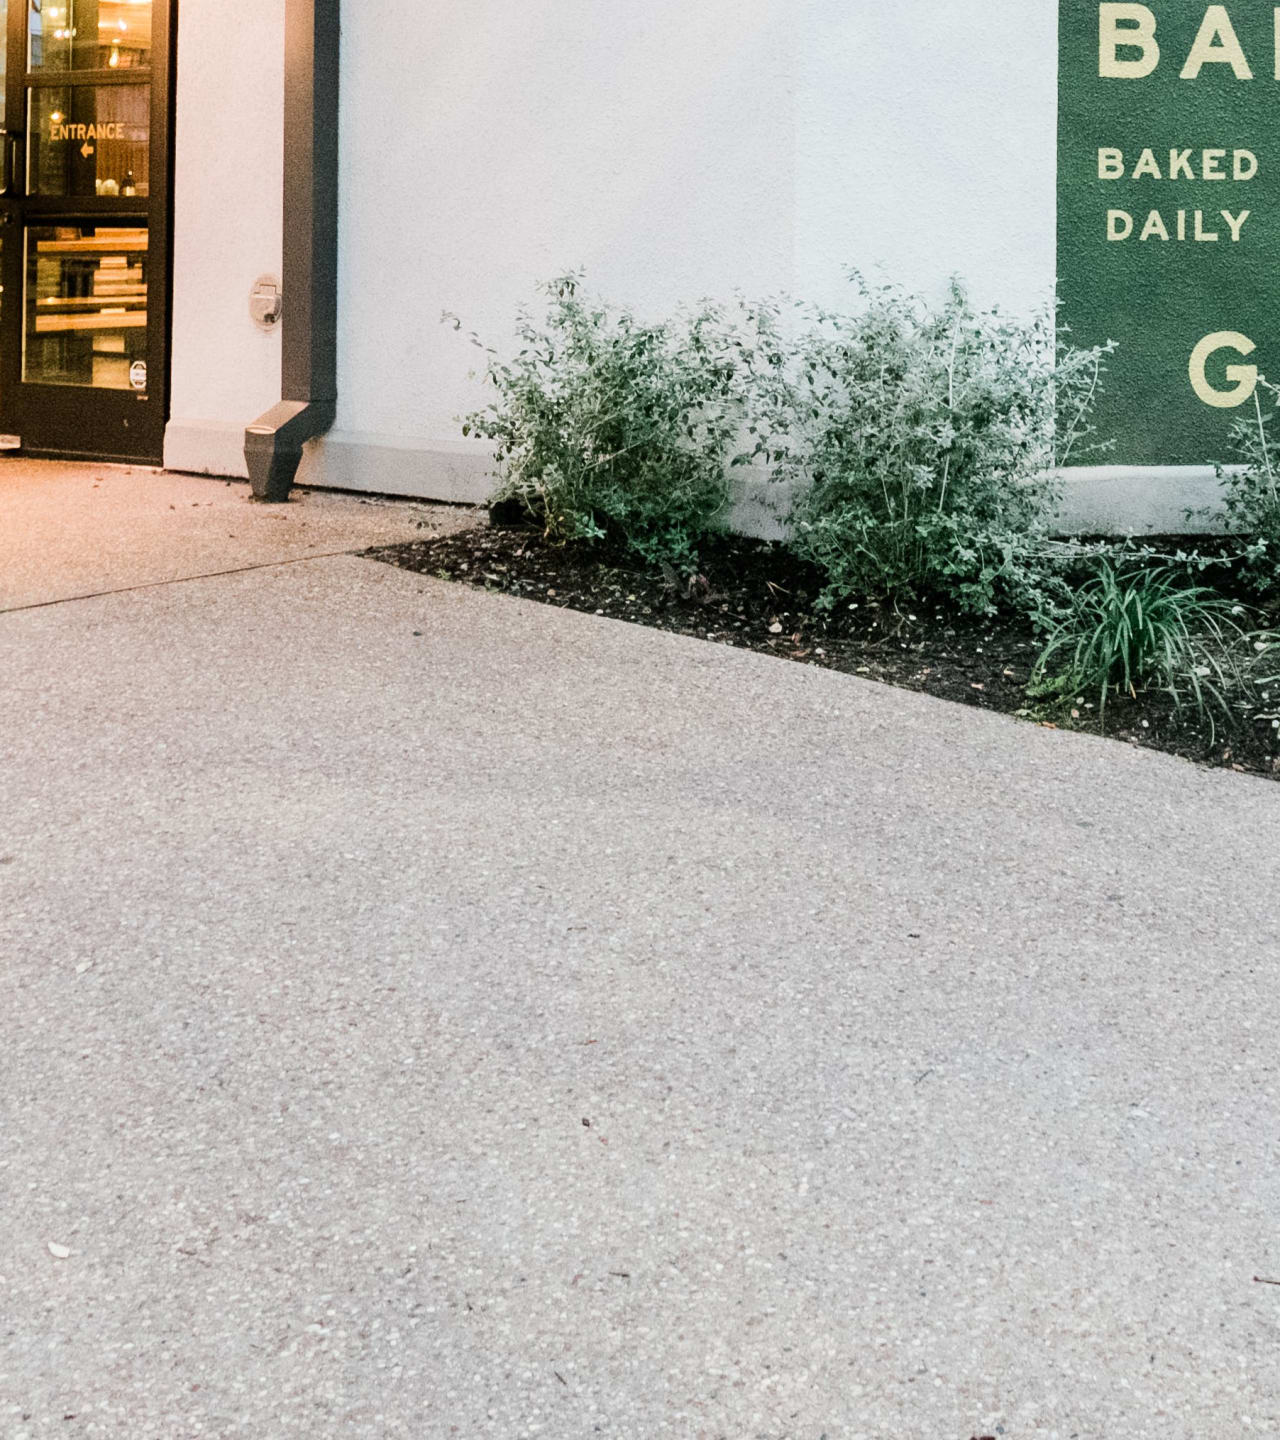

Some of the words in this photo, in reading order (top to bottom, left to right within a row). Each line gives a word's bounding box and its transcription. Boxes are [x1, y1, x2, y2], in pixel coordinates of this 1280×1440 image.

[50, 122, 126, 141] ENTRANCE
[1098, 147, 1258, 181] BAKED
[1107, 209, 1250, 242] DAILY
